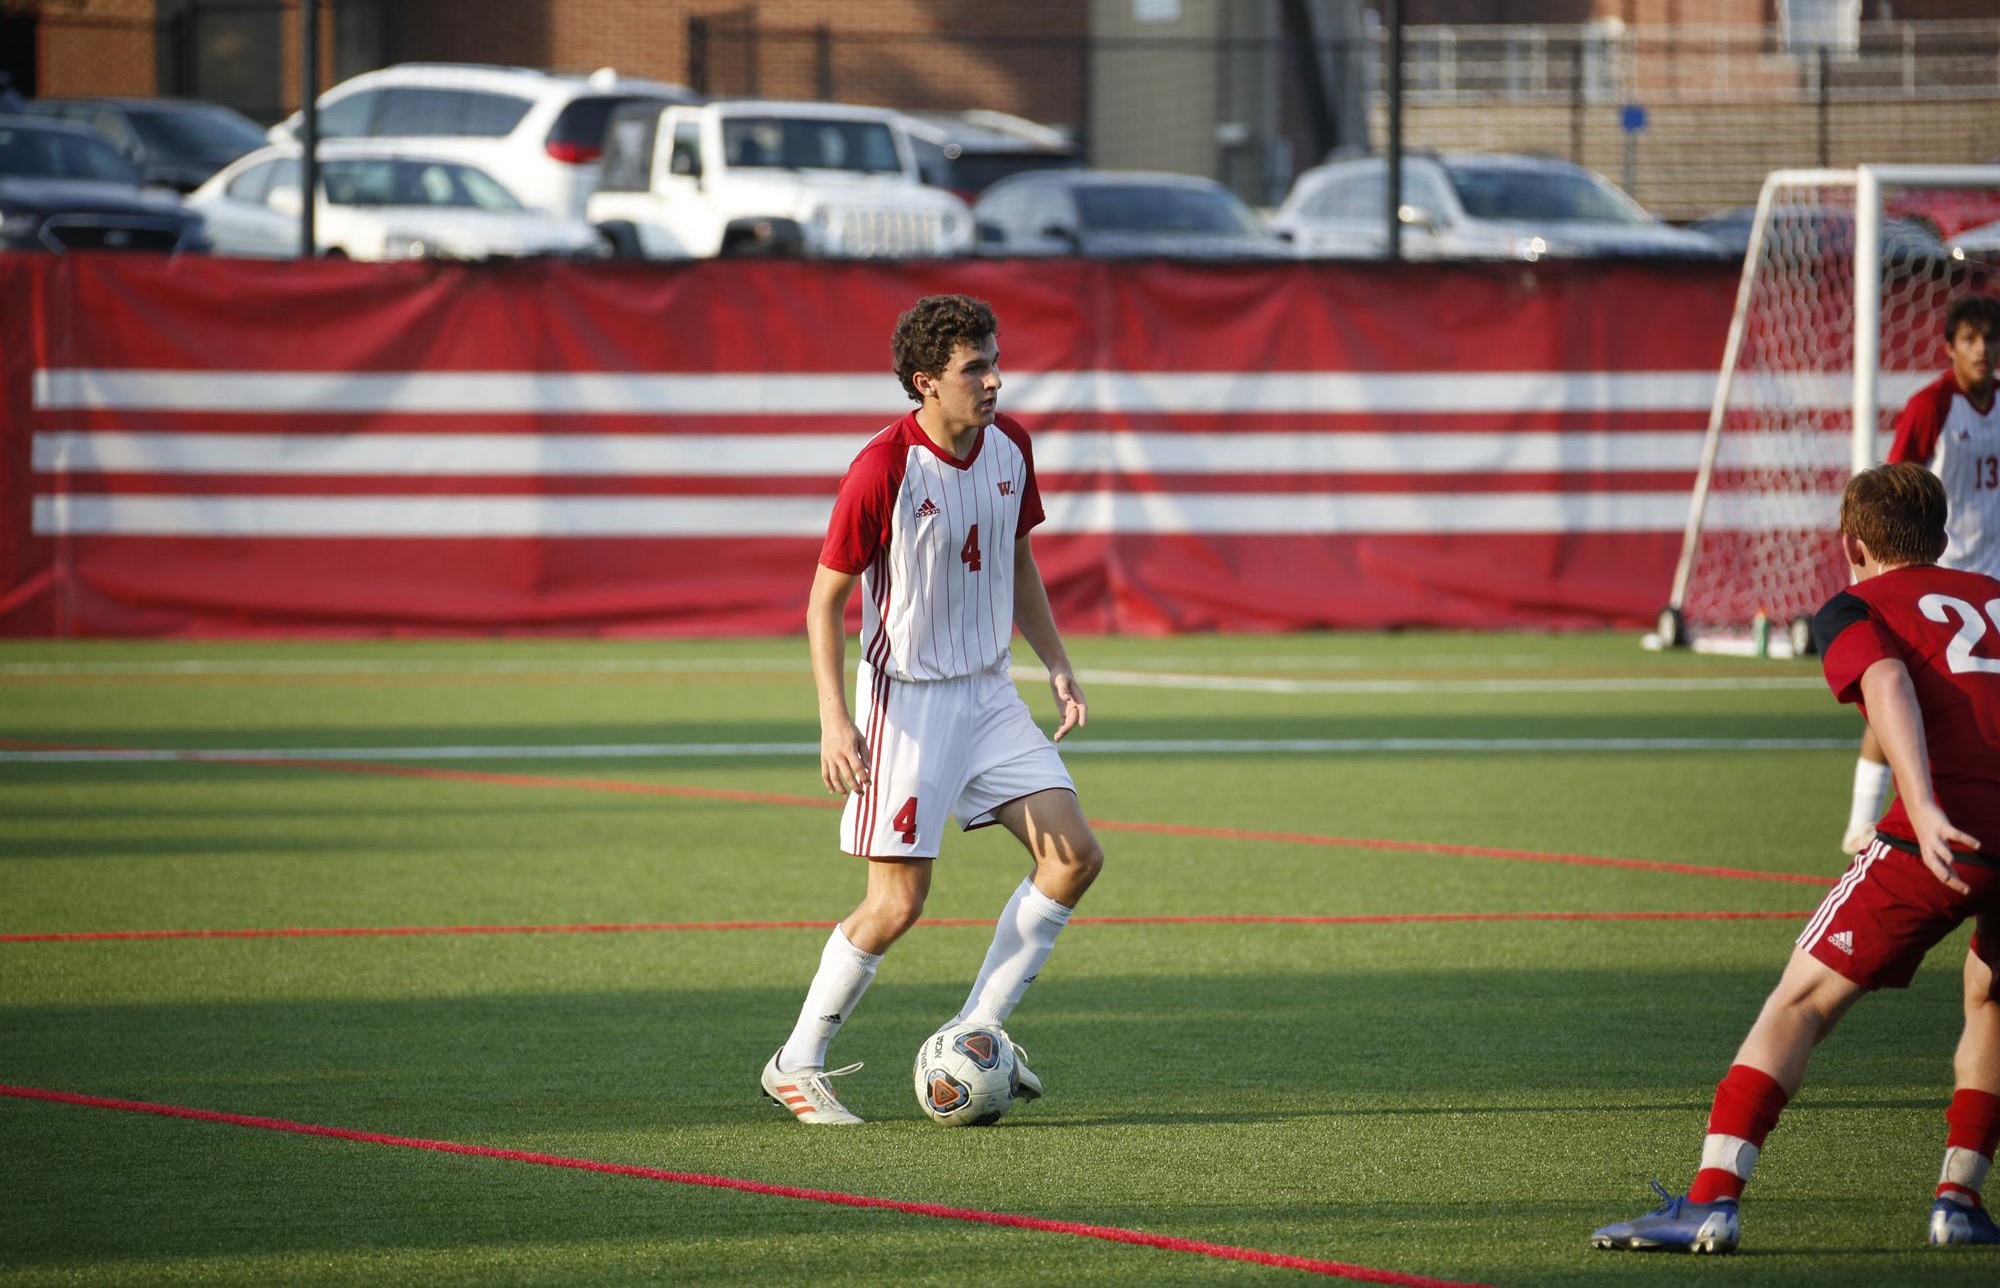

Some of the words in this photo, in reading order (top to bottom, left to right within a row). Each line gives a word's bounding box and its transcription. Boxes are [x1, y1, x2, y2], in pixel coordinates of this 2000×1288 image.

[1974, 455, 1999, 491] 13
[915, 507, 940, 518] adidas
[960, 523, 981, 573] 4
[1918, 593, 2000, 674] 2
[892, 796, 918, 844] 4
[934, 1035, 944, 1059] NCAA
